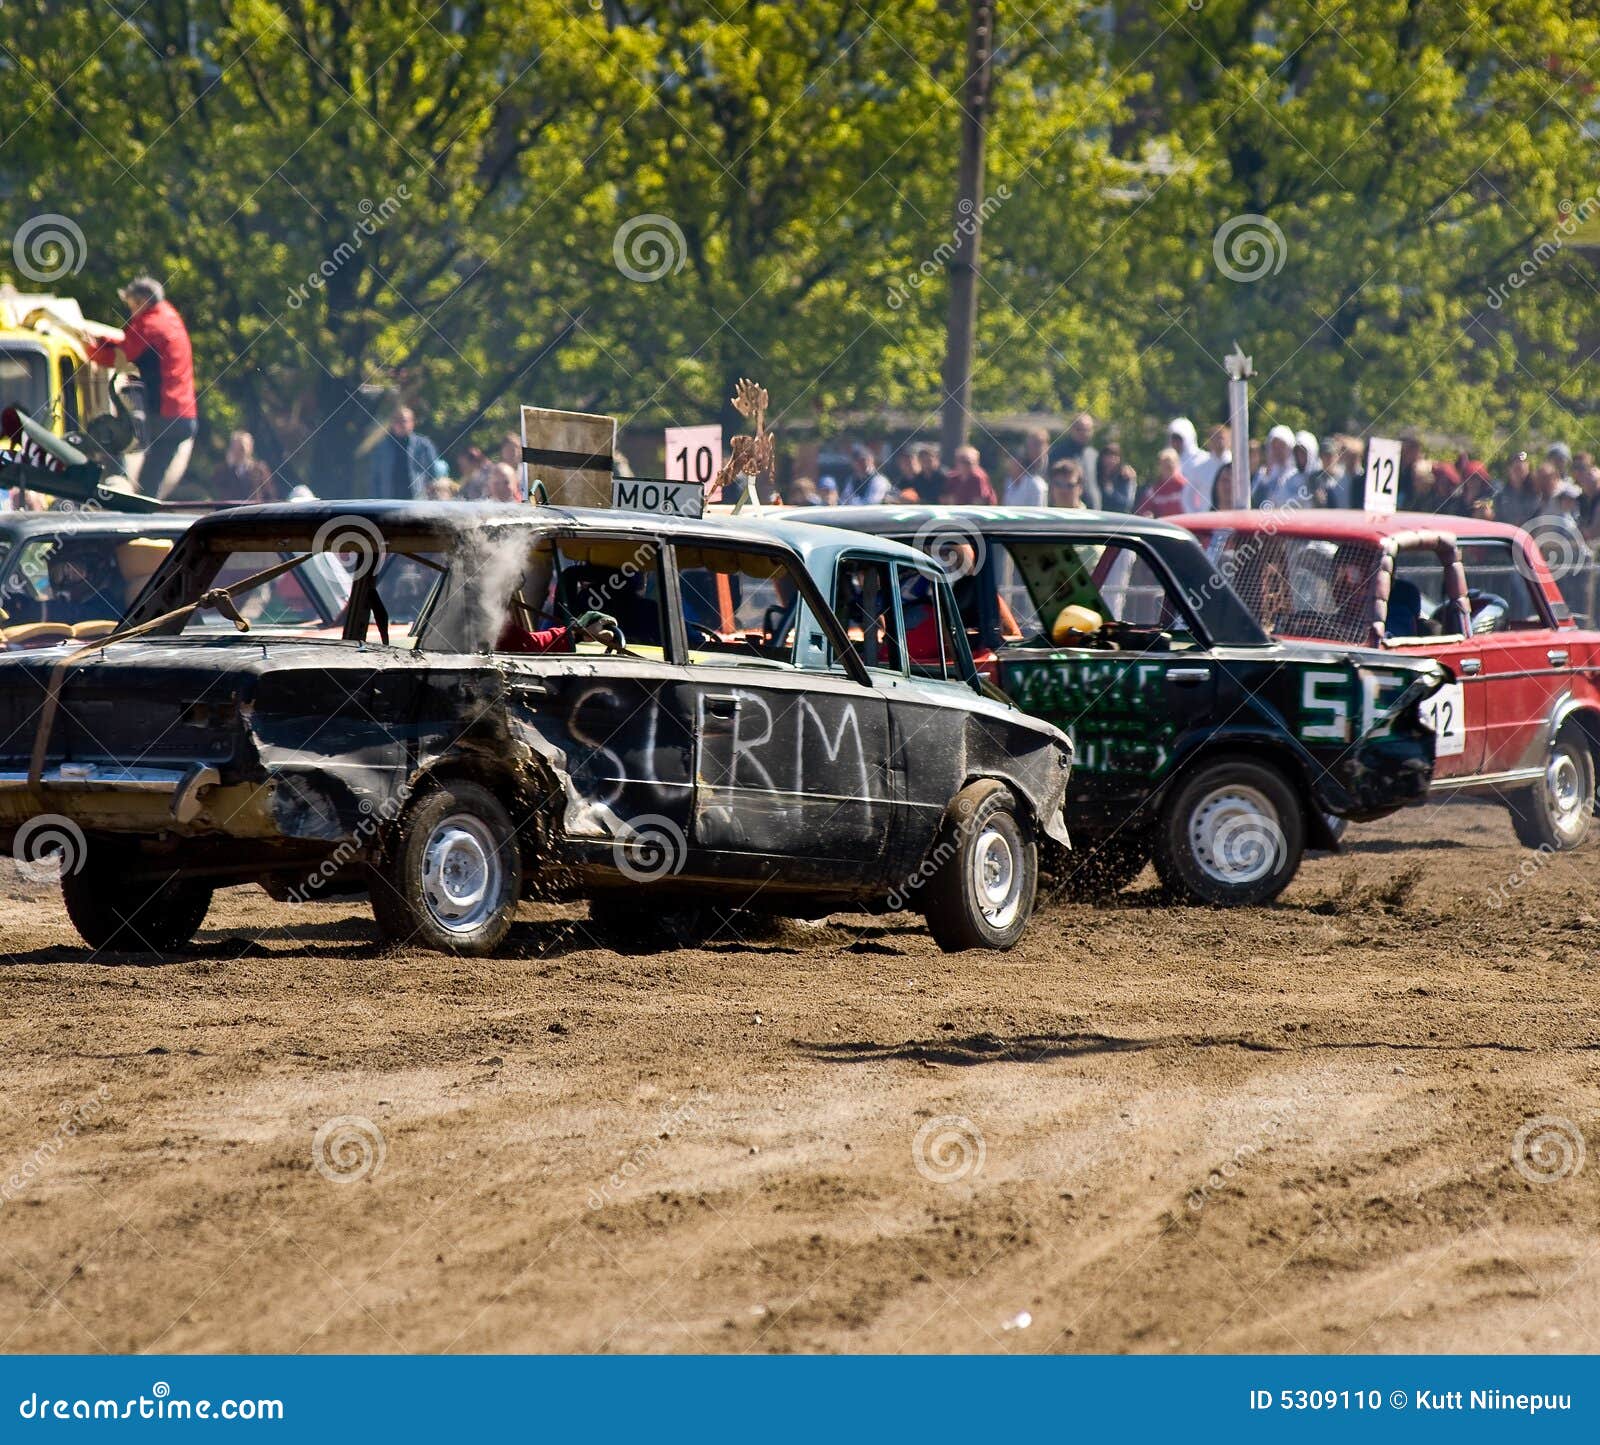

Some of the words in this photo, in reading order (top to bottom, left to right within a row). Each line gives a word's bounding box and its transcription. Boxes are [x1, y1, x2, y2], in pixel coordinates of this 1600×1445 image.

[675, 446, 713, 483] 10
[1372, 457, 1394, 495] 12
[617, 483, 681, 512] MOK
[1430, 701, 1455, 737] 12
